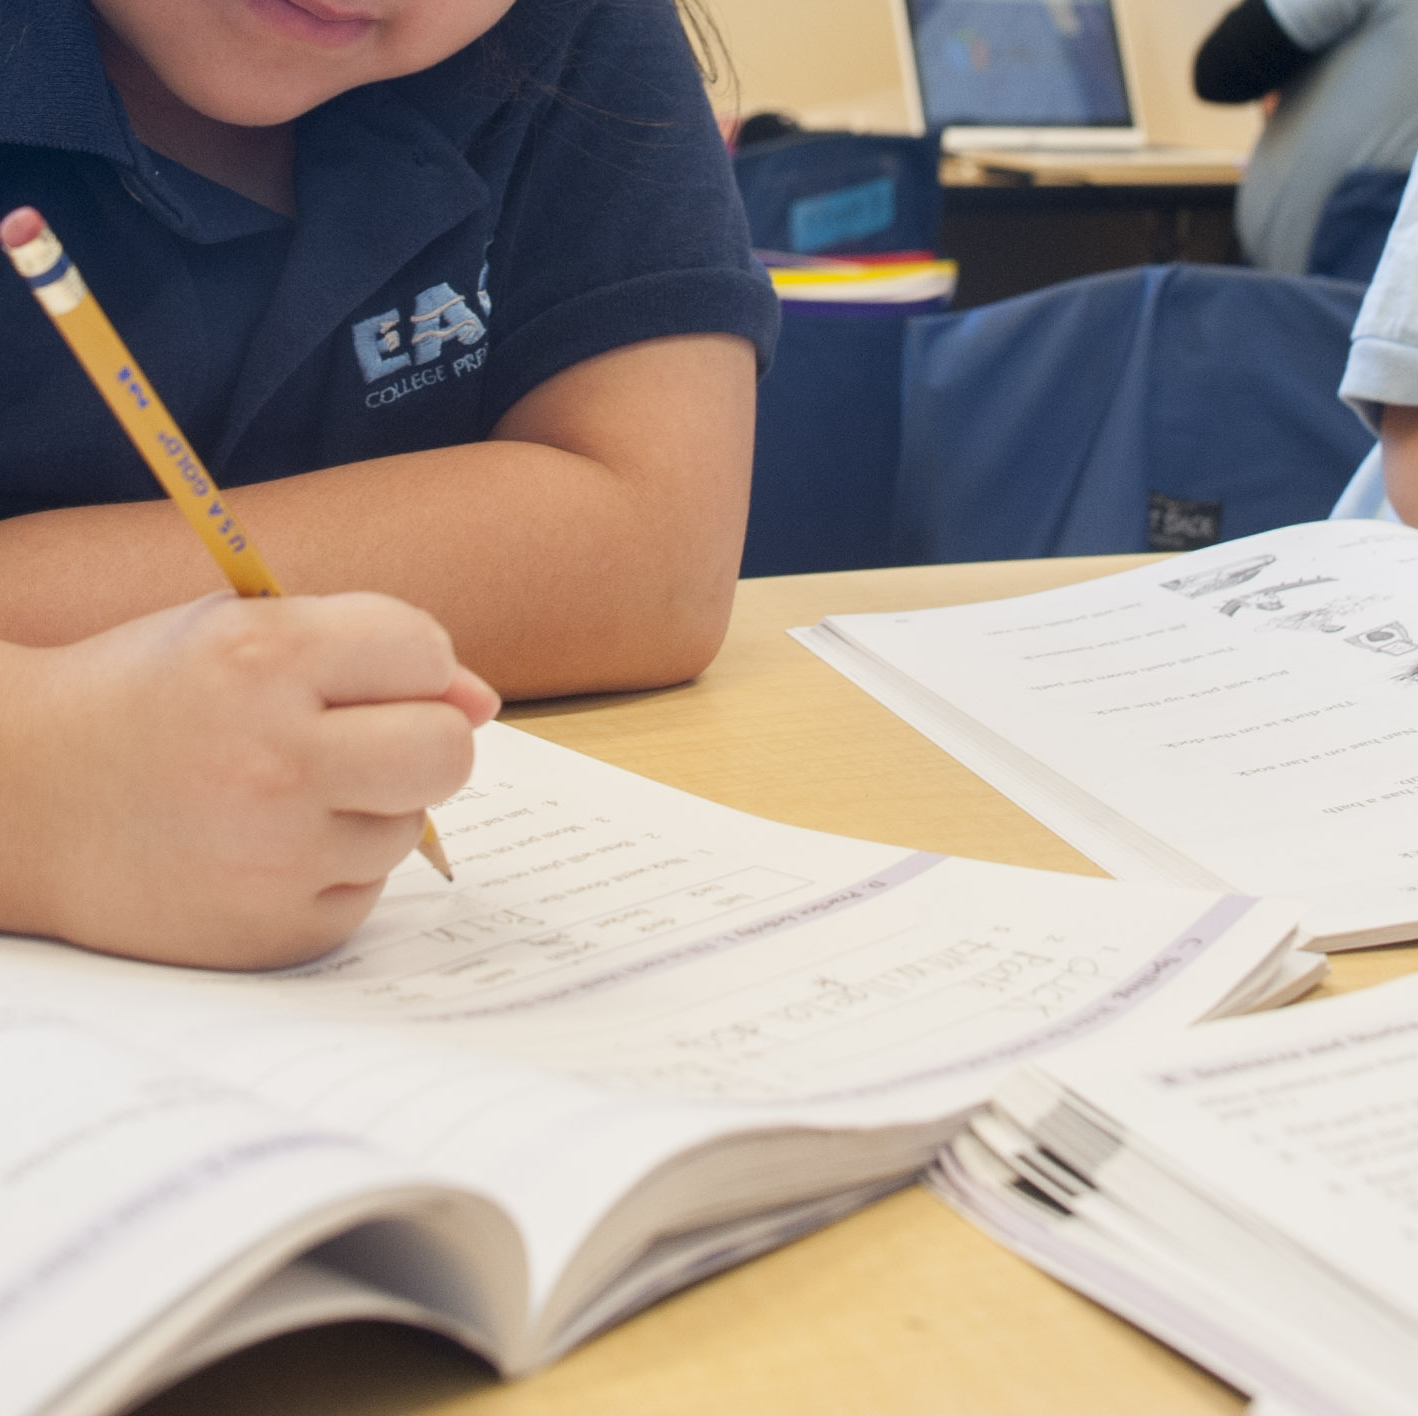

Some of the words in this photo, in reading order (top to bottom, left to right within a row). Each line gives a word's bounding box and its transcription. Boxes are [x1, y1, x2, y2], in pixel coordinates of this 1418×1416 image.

[365, 365, 445, 408] COLLEGE
[1223, 680, 1252, 690] will
[1187, 687, 1221, 698] pick
[1323, 701, 1358, 711] The
[1281, 710, 1321, 723] duck
[1238, 726, 1261, 734] on
[1381, 728, 1418, 740] Nan
[1209, 732, 1237, 741] the
[1349, 738, 1382, 750] has
[1323, 748, 1347, 756] on
[1279, 759, 1309, 767] tan
[1380, 788, 1415, 800] has
[1321, 801, 1365, 815] bath
